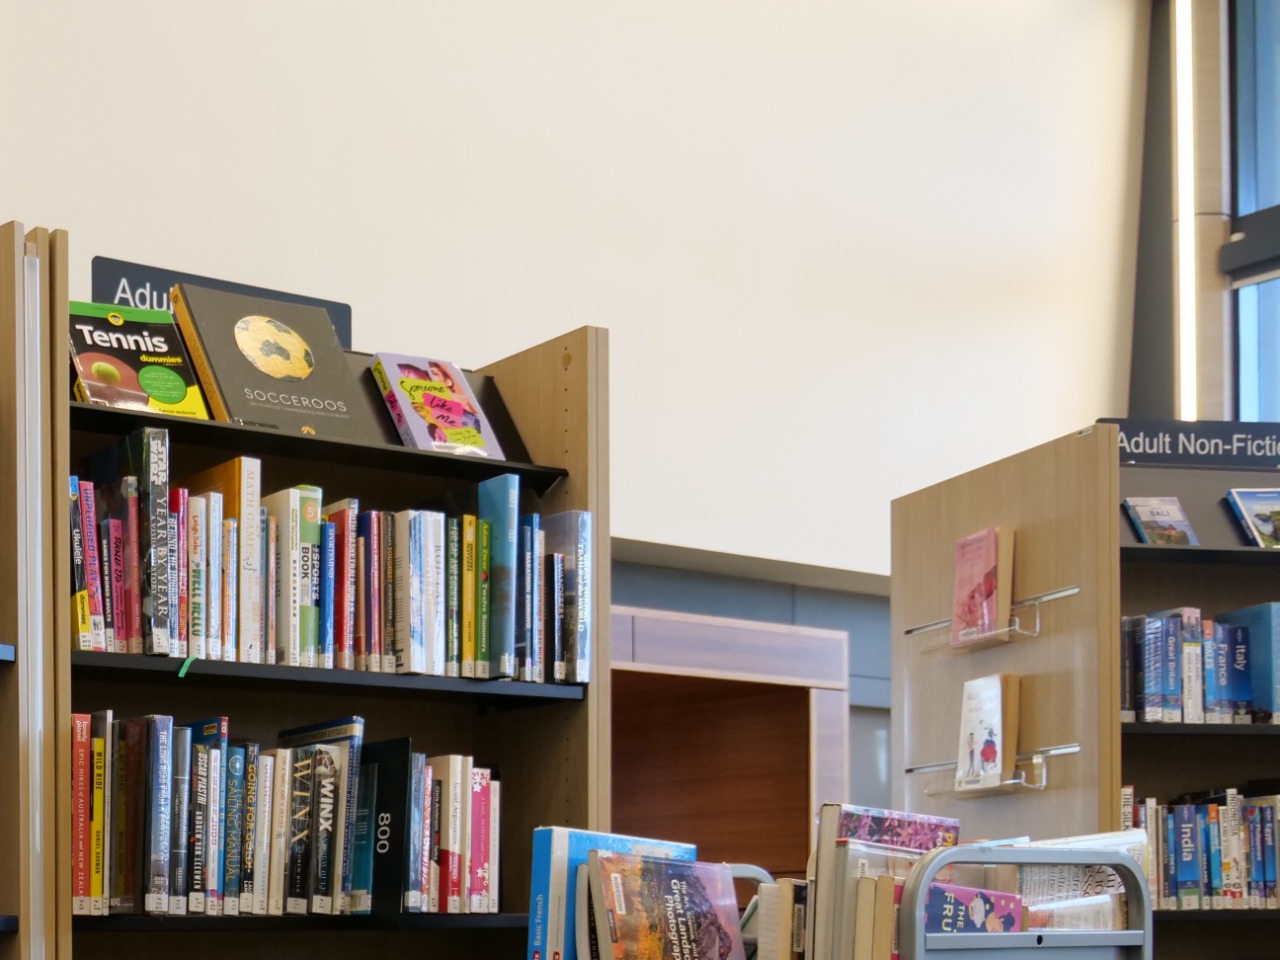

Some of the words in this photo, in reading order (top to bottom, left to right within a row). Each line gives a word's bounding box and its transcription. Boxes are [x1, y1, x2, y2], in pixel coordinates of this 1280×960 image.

[113, 277, 174, 314] Adu
[75, 324, 168, 353] Tennis
[139, 354, 184, 365] dummies
[243, 387, 347, 412] SOCCEROOS
[1117, 431, 1171, 454] Adult
[1178, 432, 1280, 456] Non-Ficti
[73, 528, 81, 565] Ukulele
[302, 546, 310, 579] BOOK
[1219, 643, 1227, 686] France
[1233, 645, 1245, 670] Italy
[319, 778, 334, 832] WINX
[376, 812, 391, 853] 800
[1181, 823, 1193, 862] India
[534, 893, 543, 923] French
[670, 879, 683, 914] Great
[534, 924, 543, 946] Basic
